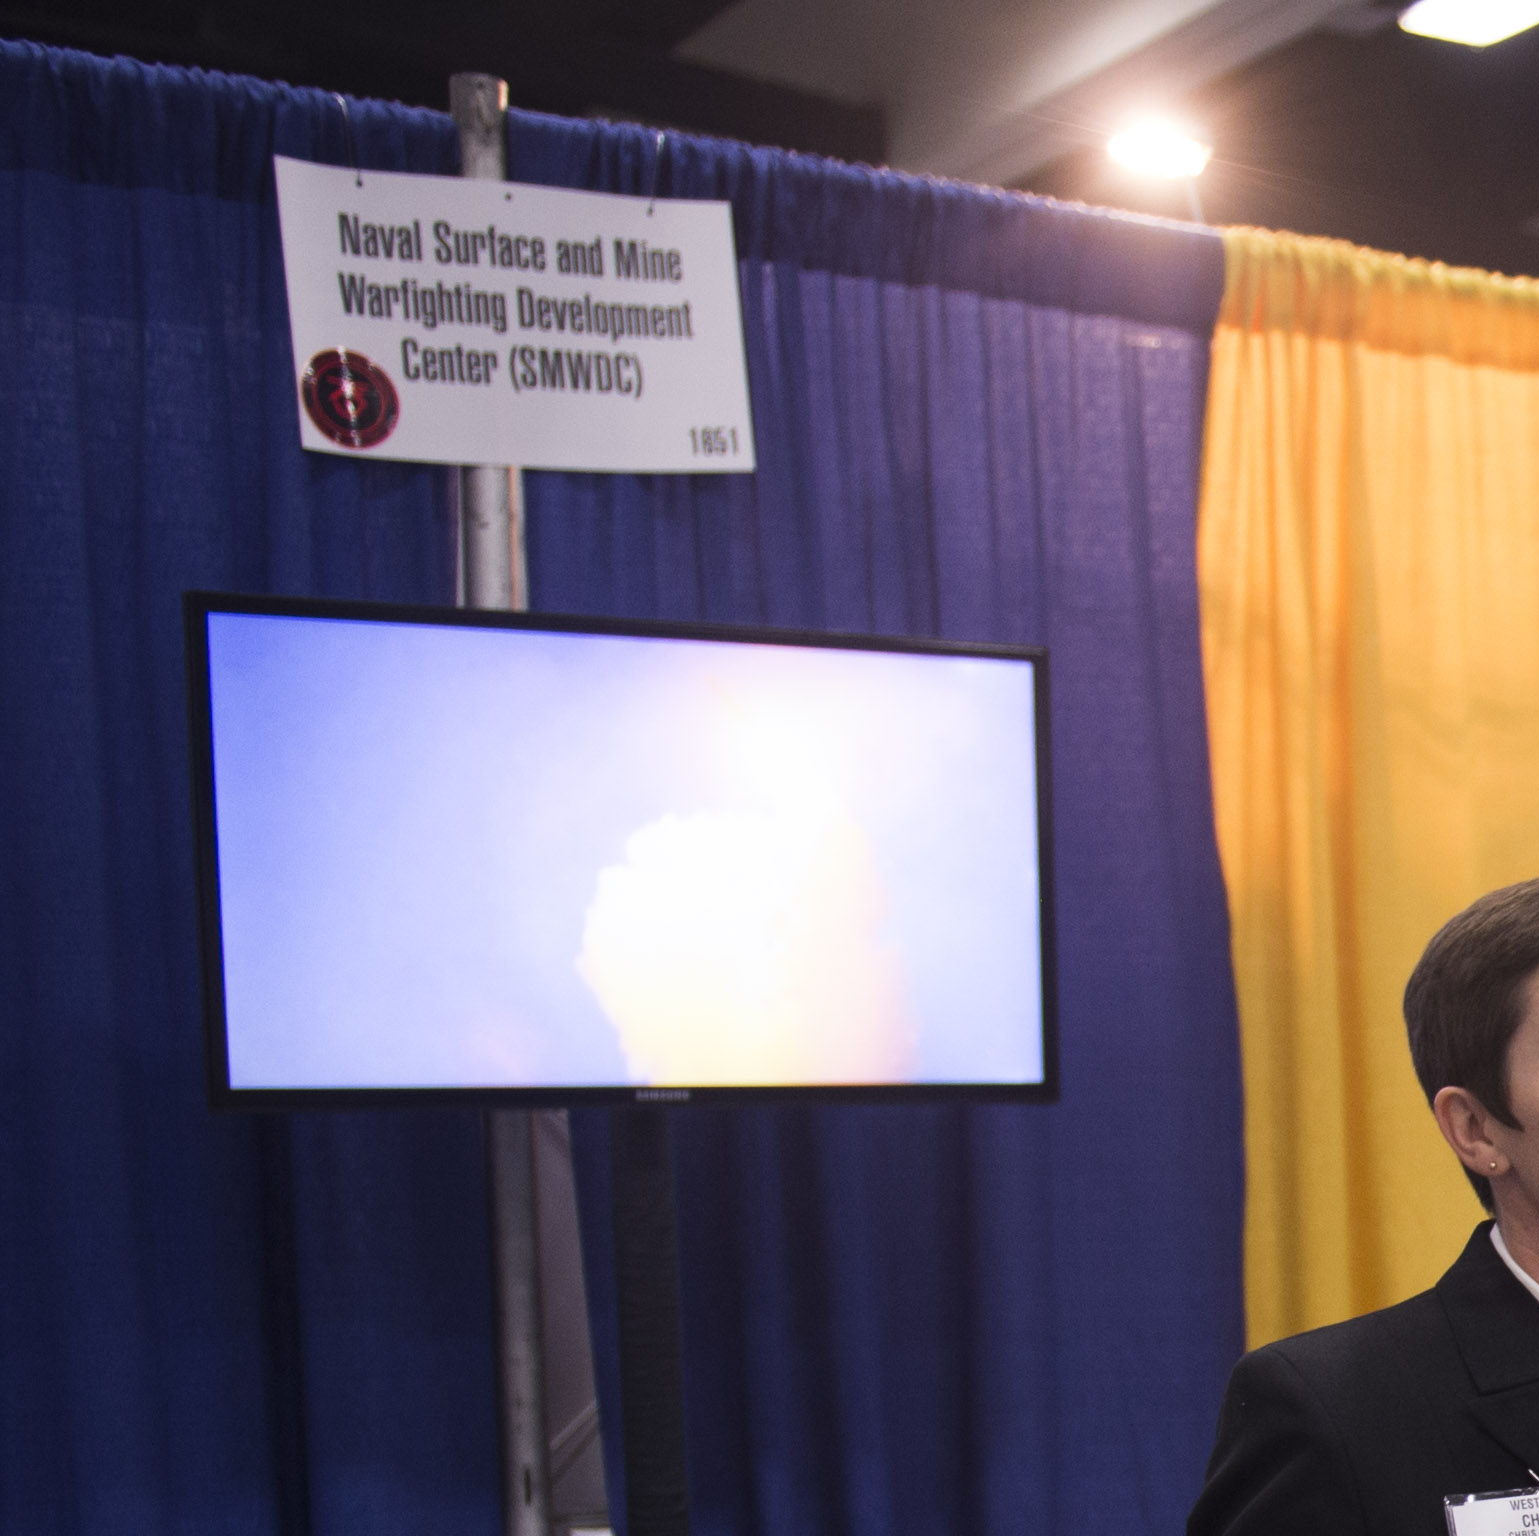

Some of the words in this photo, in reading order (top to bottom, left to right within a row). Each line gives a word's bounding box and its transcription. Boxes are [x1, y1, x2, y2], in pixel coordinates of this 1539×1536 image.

[338, 212, 423, 262] Naval
[434, 220, 546, 271] Surface
[556, 235, 605, 277] and
[614, 239, 682, 282] Mine
[338, 272, 507, 333] Warfighting
[517, 287, 693, 342] Development
[401, 338, 499, 385] Center
[510, 344, 644, 400] (SMWDC)
[688, 426, 739, 457] 1851
[1510, 1498, 1539, 1511] WEST
